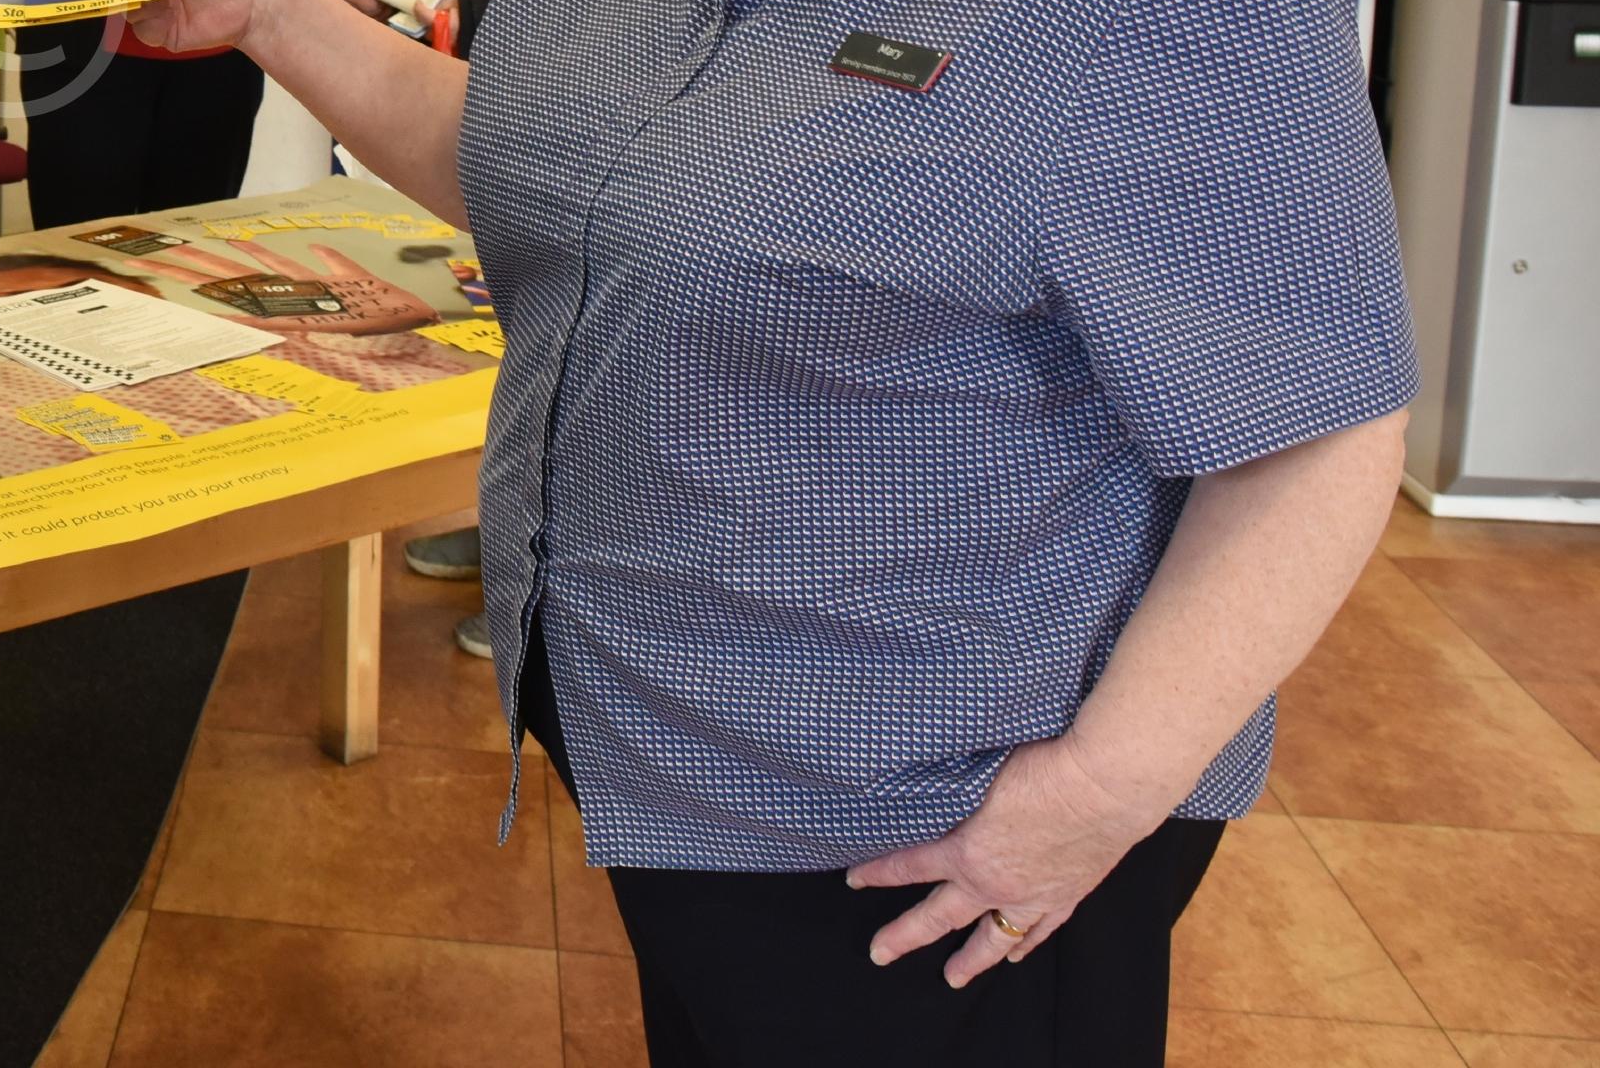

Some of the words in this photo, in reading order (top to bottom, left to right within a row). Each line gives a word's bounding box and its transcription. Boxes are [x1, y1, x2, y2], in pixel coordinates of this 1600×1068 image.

[55, 1, 88, 15] Stop
[264, 285, 295, 293] 101
[2, 490, 16, 501] at
[21, 464, 132, 495] impersonating
[192, 428, 285, 456] organisations
[288, 419, 317, 433] and
[78, 479, 107, 495] you
[106, 473, 128, 485] for
[135, 464, 171, 477] their
[225, 440, 276, 462] hoping
[3, 529, 17, 540] It
[21, 517, 69, 537] could
[72, 503, 135, 528] protect
[136, 497, 165, 514] you
[167, 487, 199, 503] and
[200, 479, 235, 497] your
[237, 465, 293, 486] money.
